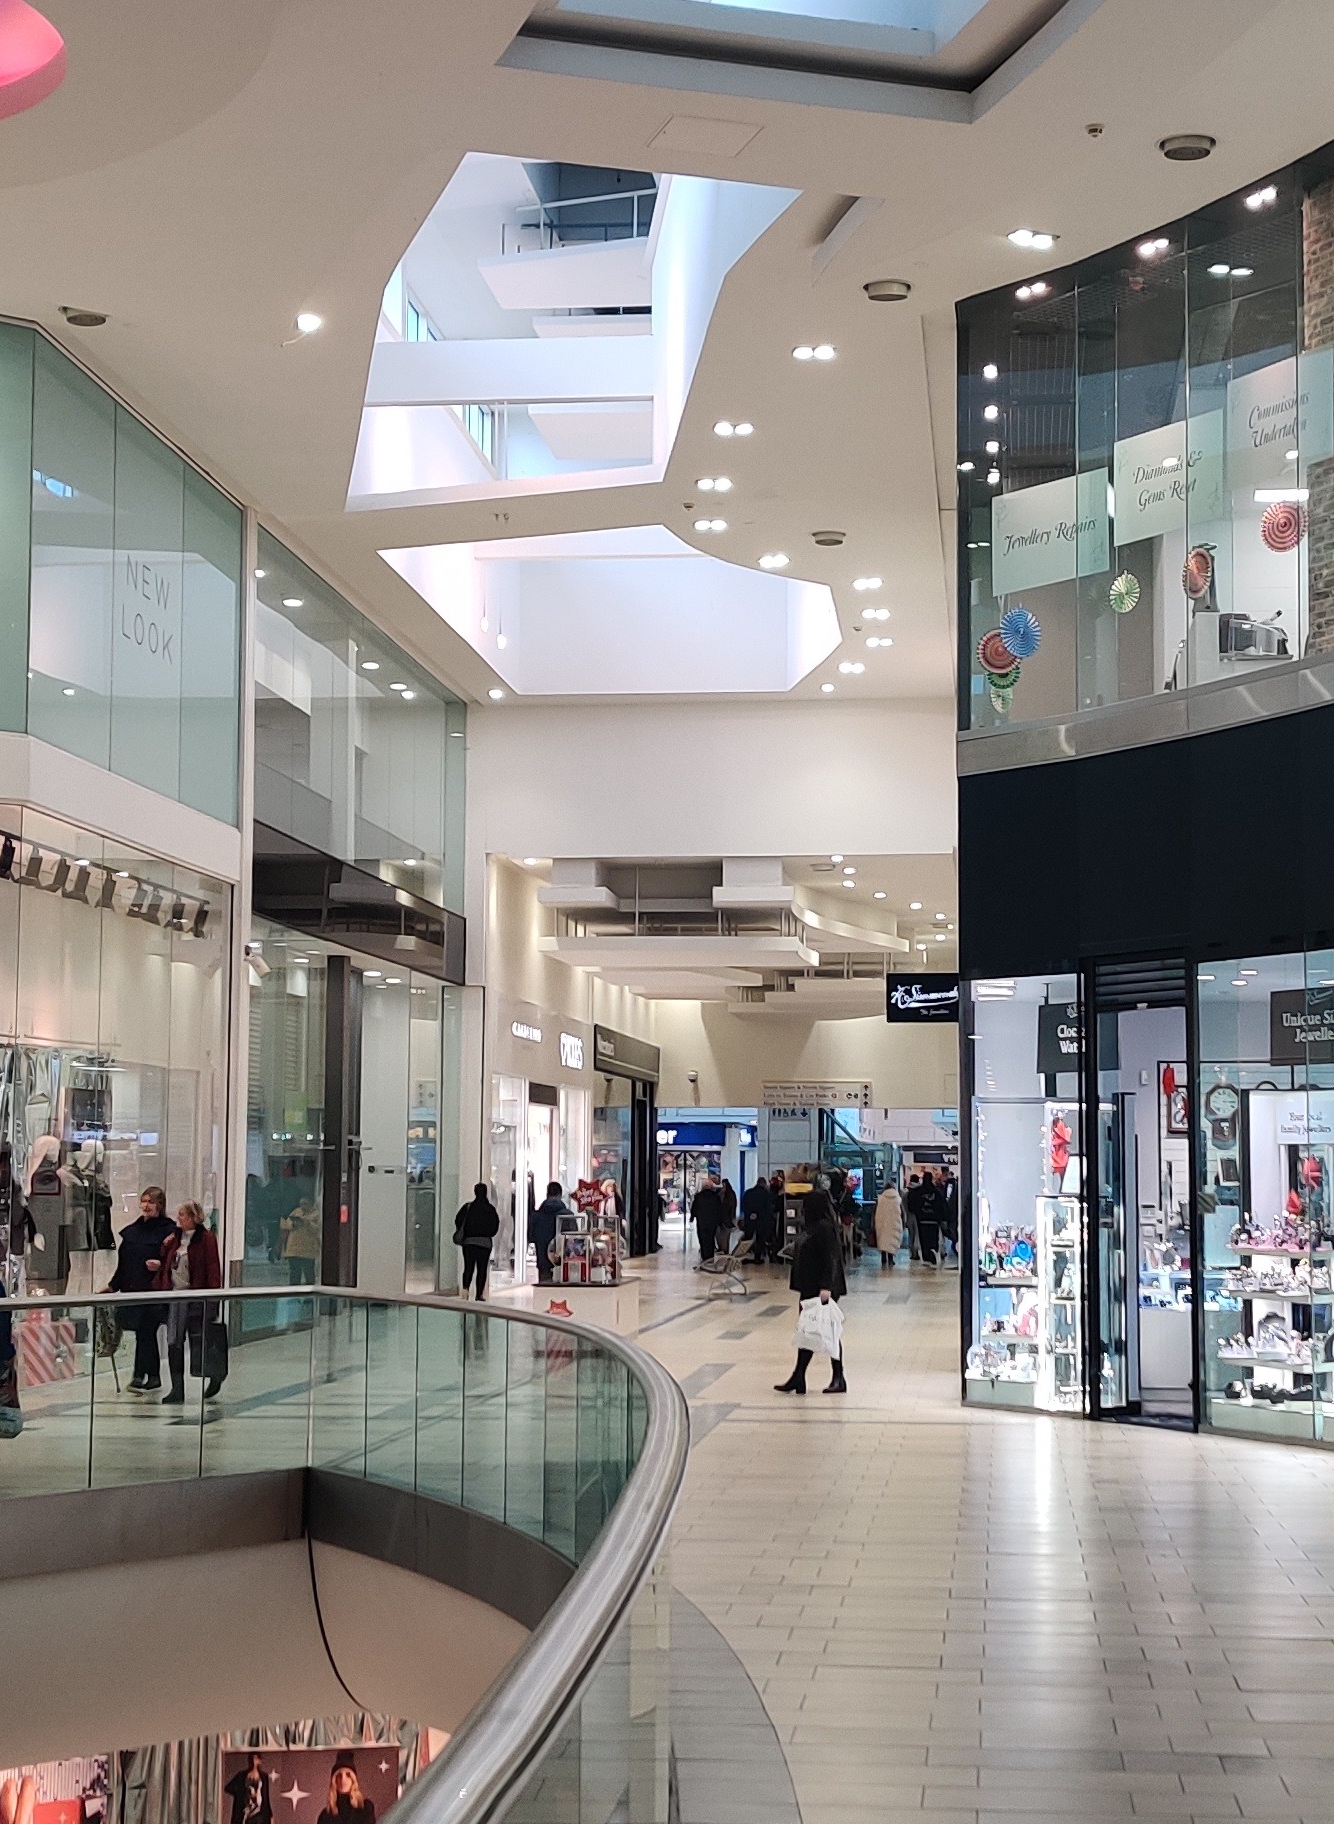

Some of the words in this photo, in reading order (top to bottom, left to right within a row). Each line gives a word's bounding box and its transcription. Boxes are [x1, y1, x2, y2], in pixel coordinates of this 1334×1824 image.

[126, 553, 170, 611] NEW
[122, 603, 174, 665] LOOK
[1281, 1011, 1322, 1029] Unique
